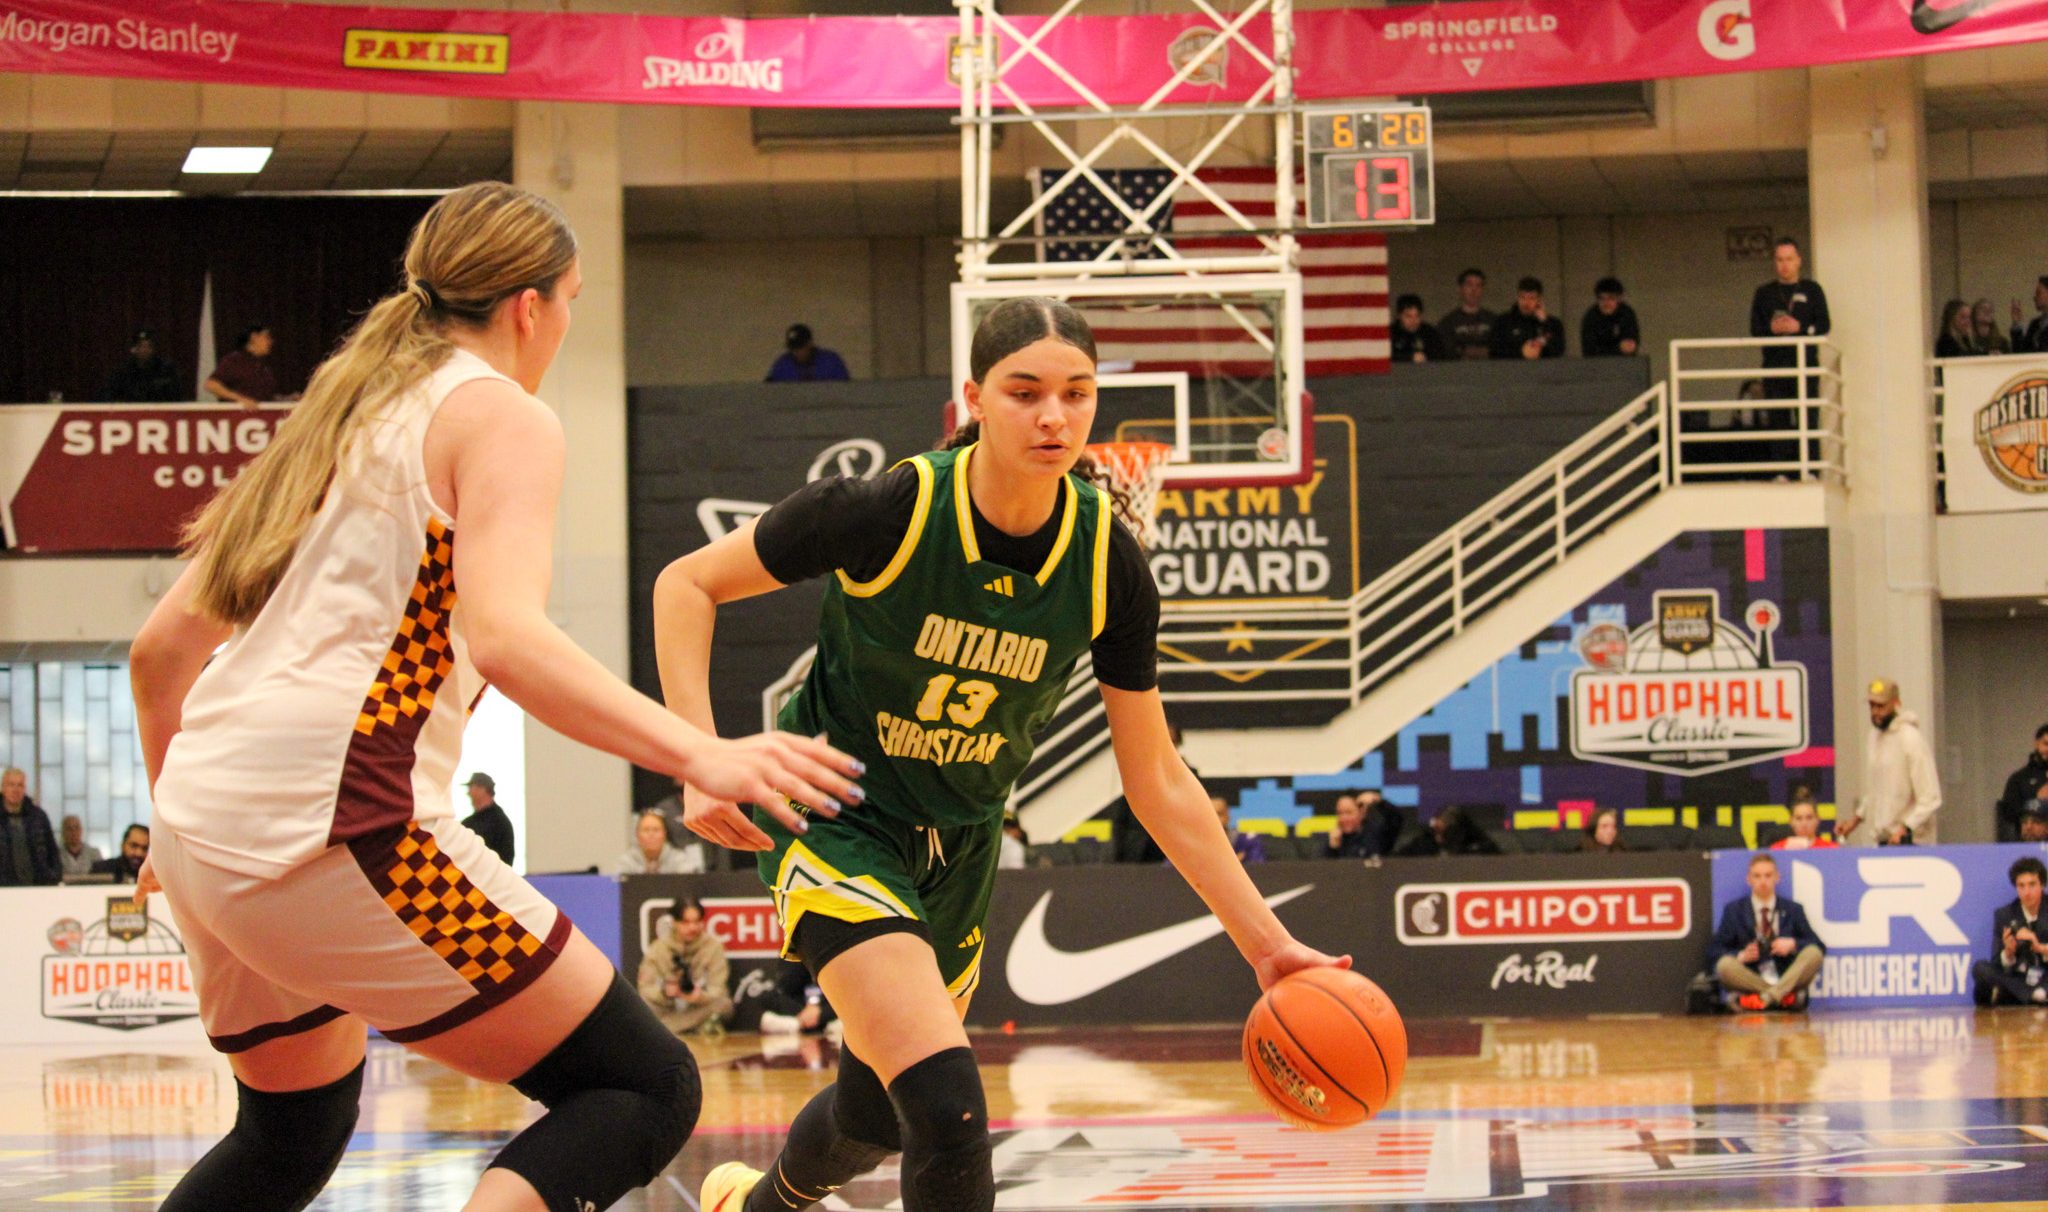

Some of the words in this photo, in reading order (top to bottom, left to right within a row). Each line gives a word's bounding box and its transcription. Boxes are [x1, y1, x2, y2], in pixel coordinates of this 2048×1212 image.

[0, 12, 110, 51] Morgan
[116, 19, 237, 62] Stanley
[1384, 15, 1557, 40] SPRINGFIELD
[356, 38, 498, 64] PANINI
[1428, 39, 1514, 54] COLLEGE
[643, 56, 782, 92] SPALDING
[1354, 158, 1410, 219] 13
[62, 418, 284, 456] SPRING
[154, 465, 248, 488] COL
[1152, 518, 1329, 550] NATIONAL
[1150, 550, 1331, 597] GUARD
[914, 613, 1048, 683] ONTARIO
[915, 673, 1000, 729] 13
[1588, 679, 1793, 727] HOOPHALL
[876, 711, 1009, 766] CHRISTIAN
[1647, 717, 1730, 745] Classic
[706, 913, 780, 944] CHI
[1463, 894, 1675, 929] CHIPOTLE
[51, 962, 191, 996] HOOPHAL
[733, 968, 775, 1005] fo
[1491, 954, 1533, 990] for
[1535, 951, 1599, 989] Real
[1809, 953, 1972, 999] EAGUEREADY
[95, 990, 158, 1012] Classic
